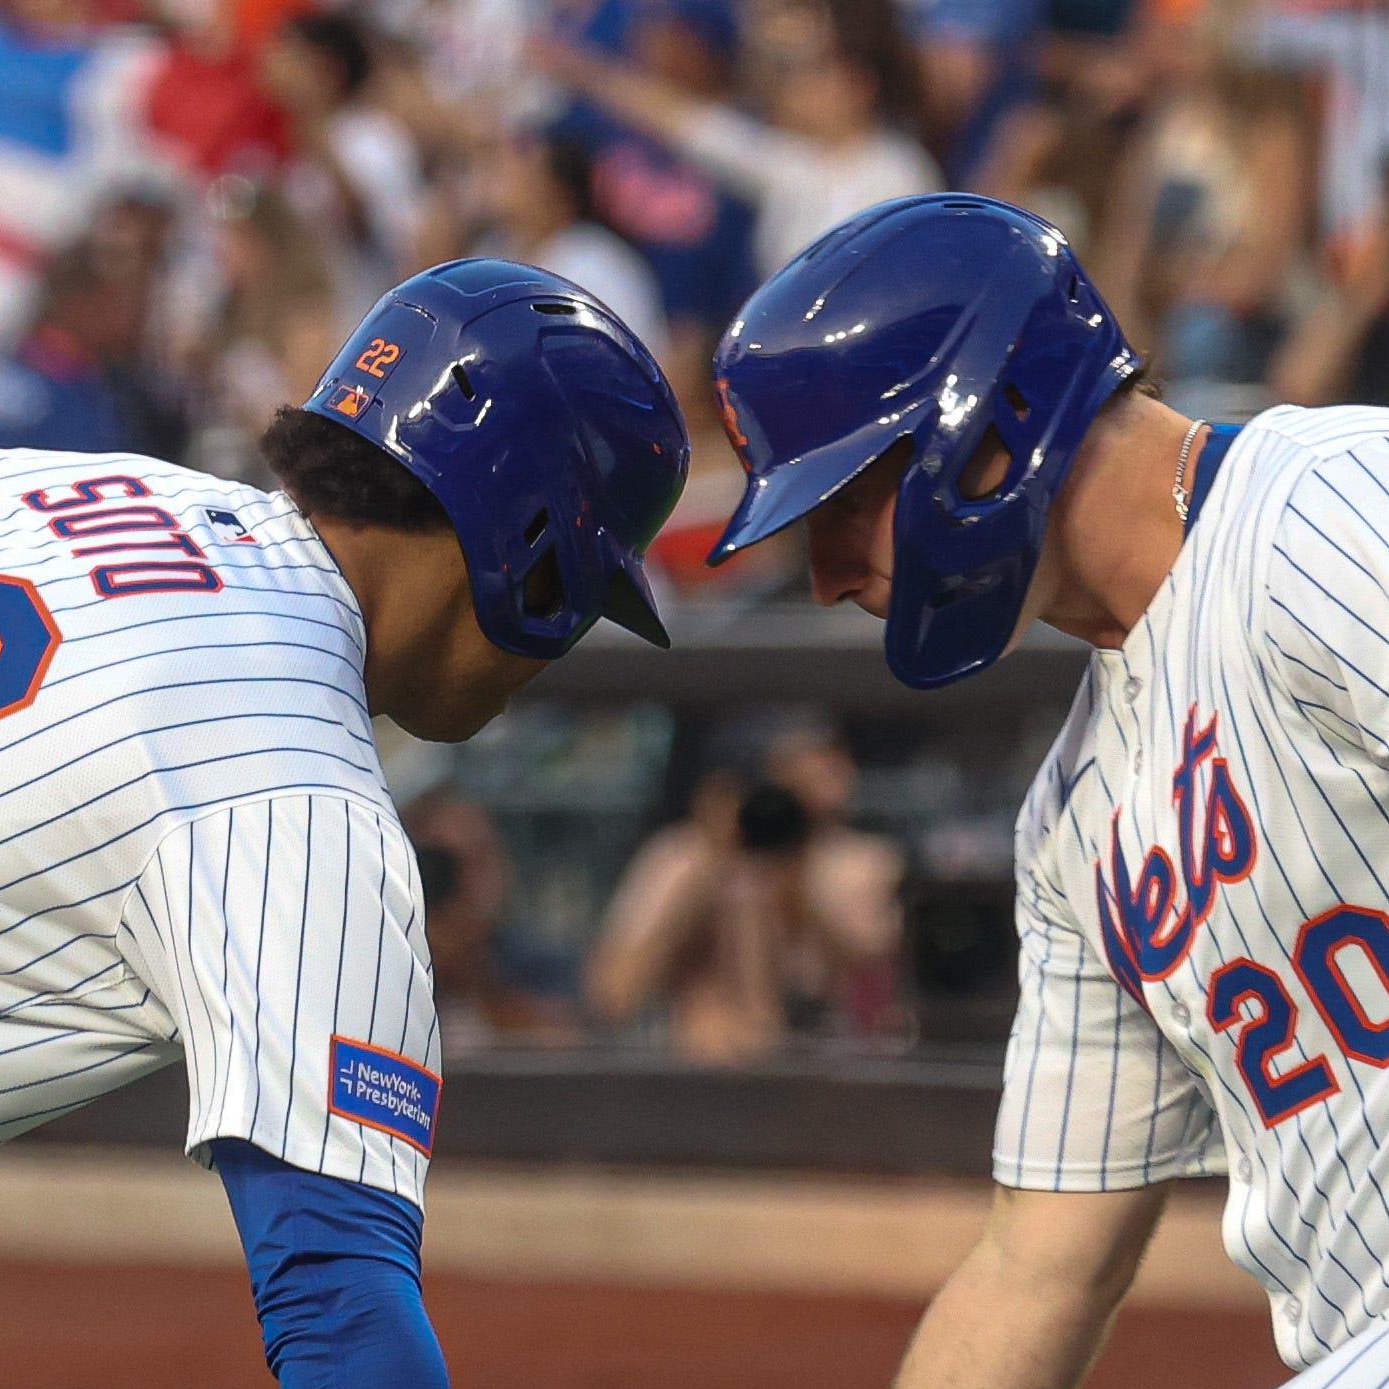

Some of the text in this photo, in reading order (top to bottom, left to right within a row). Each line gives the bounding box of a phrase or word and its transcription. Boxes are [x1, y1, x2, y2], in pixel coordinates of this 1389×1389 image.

[355, 338, 401, 378] 22
[21, 474, 225, 599] SOTO
[357, 1063, 421, 1099] NewYork-
[357, 1081, 430, 1131] Presbyterian
